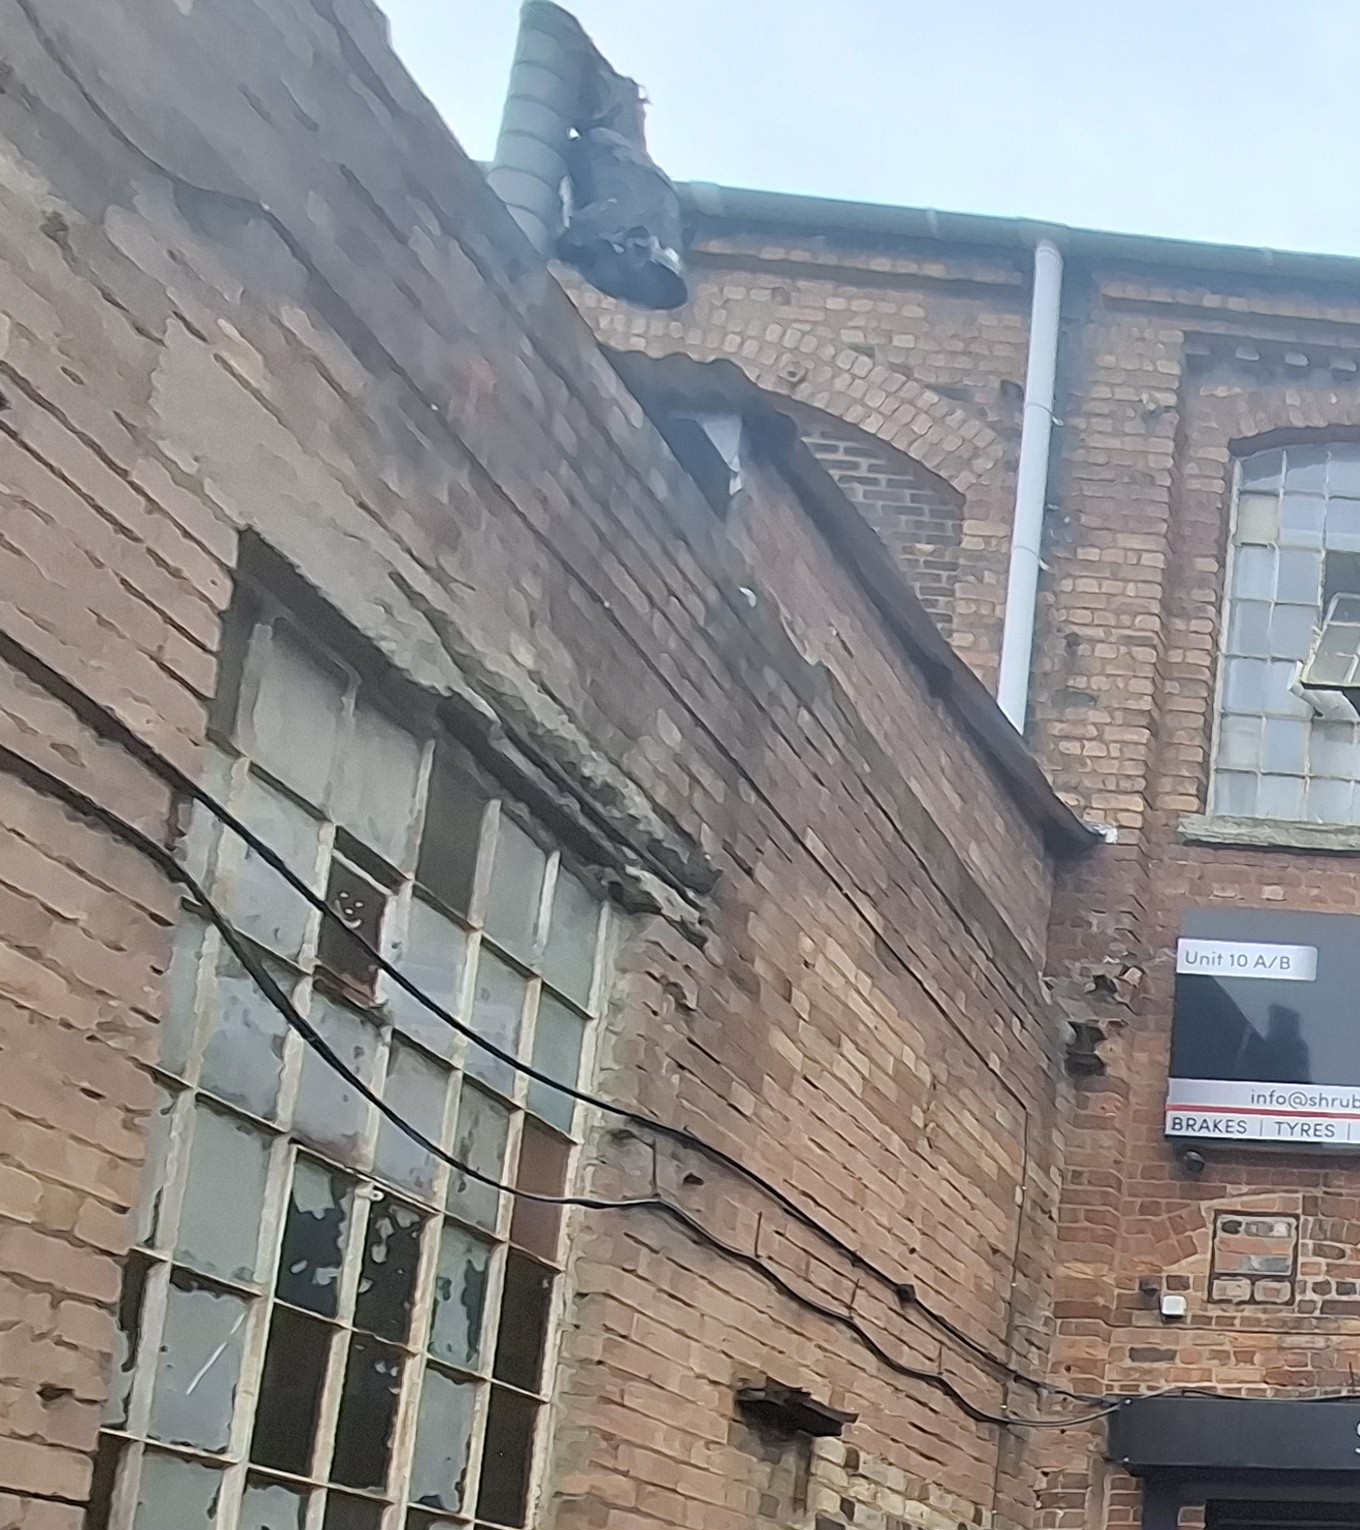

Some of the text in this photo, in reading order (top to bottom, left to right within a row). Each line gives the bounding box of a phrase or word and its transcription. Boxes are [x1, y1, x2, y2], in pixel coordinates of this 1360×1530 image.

[1185, 950, 1291, 970] Unit 10 A/B
[1170, 1117, 1248, 1135] BRAKES
[1275, 1121, 1336, 1139] TYRES
